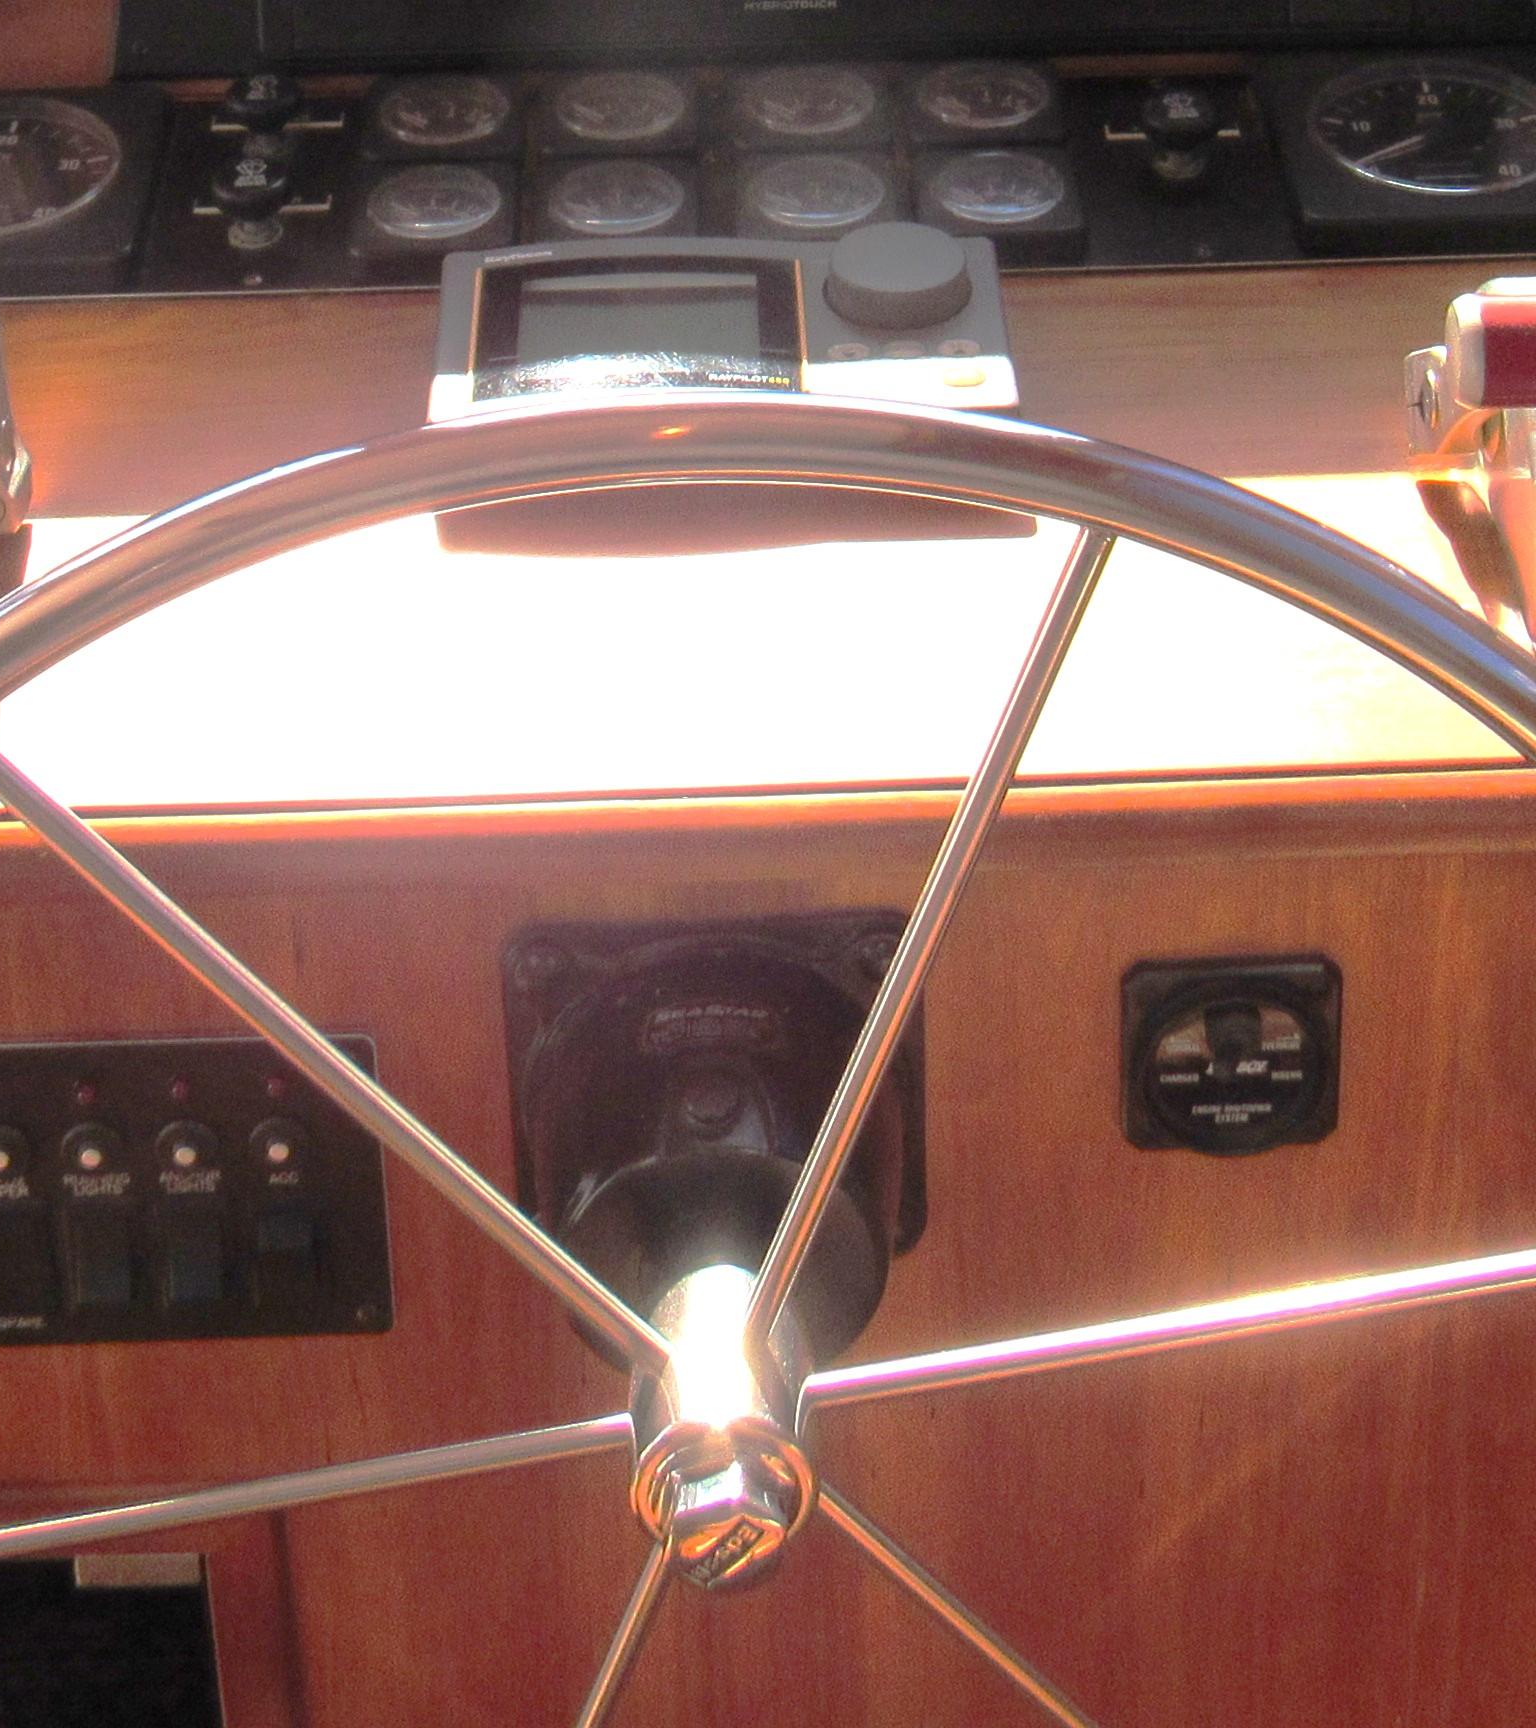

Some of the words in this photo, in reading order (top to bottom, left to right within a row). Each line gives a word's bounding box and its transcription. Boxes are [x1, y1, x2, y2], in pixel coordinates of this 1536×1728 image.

[1416, 92, 1441, 106] 20
[1350, 120, 1372, 133] 10
[58, 158, 82, 172] 30
[1497, 162, 1523, 177] 40
